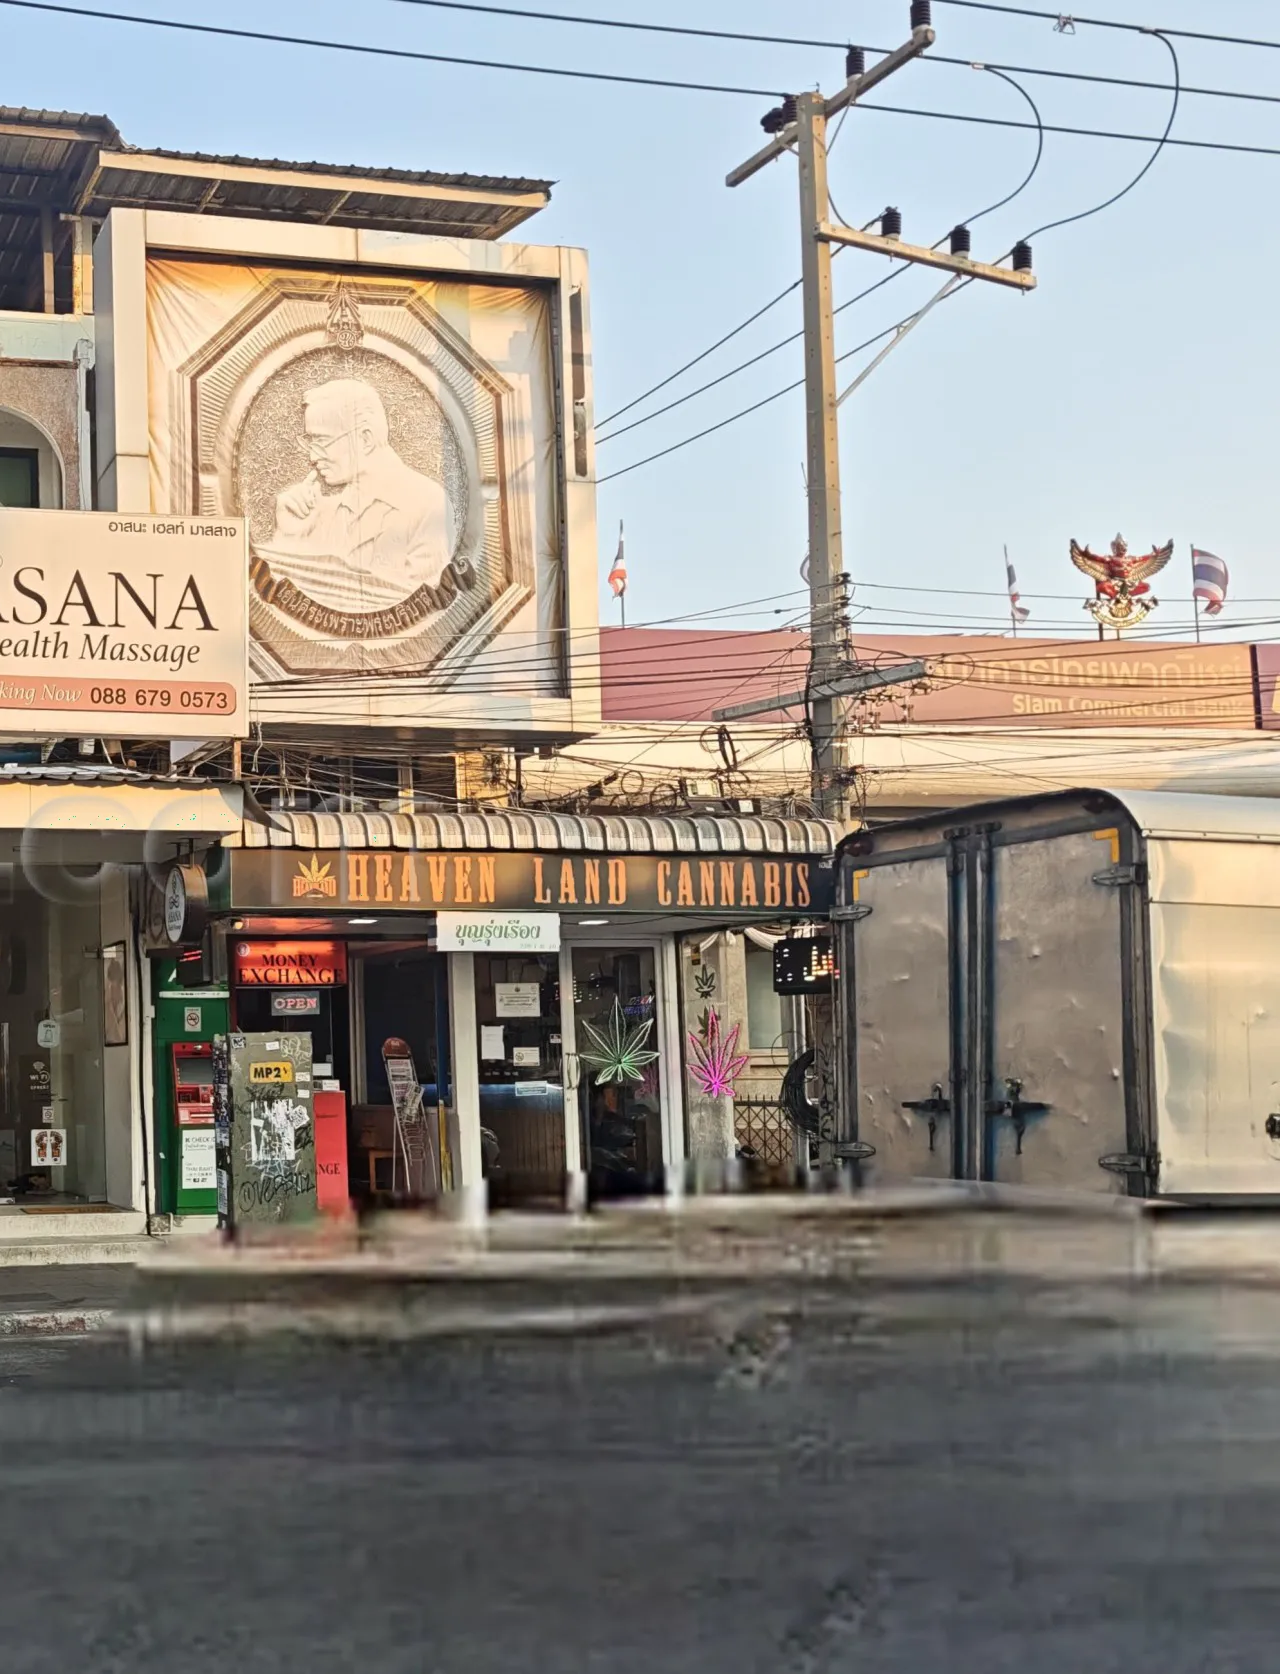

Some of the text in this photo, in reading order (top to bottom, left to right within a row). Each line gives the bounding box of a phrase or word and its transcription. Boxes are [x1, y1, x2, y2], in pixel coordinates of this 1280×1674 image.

[108, 521, 237, 537] อาสนะ เฮลท์ มาสสาจ
[79, 633, 201, 672] Massage
[41, 684, 83, 702] Now
[90, 687, 127, 705] 088
[135, 690, 171, 707] 679
[180, 691, 228, 709] 0573
[1012, 694, 1062, 714] Siam
[1068, 696, 1187, 717] Commercial
[347, 854, 495, 903] HEAVEN
[533, 857, 627, 904] LAND
[657, 860, 811, 908] CANNABIS
[455, 919, 541, 946] บุญรุ่งเรือง
[261, 954, 318, 967] MONEY
[238, 968, 344, 984] EXCHANGE
[274, 998, 317, 1010] OPEN
